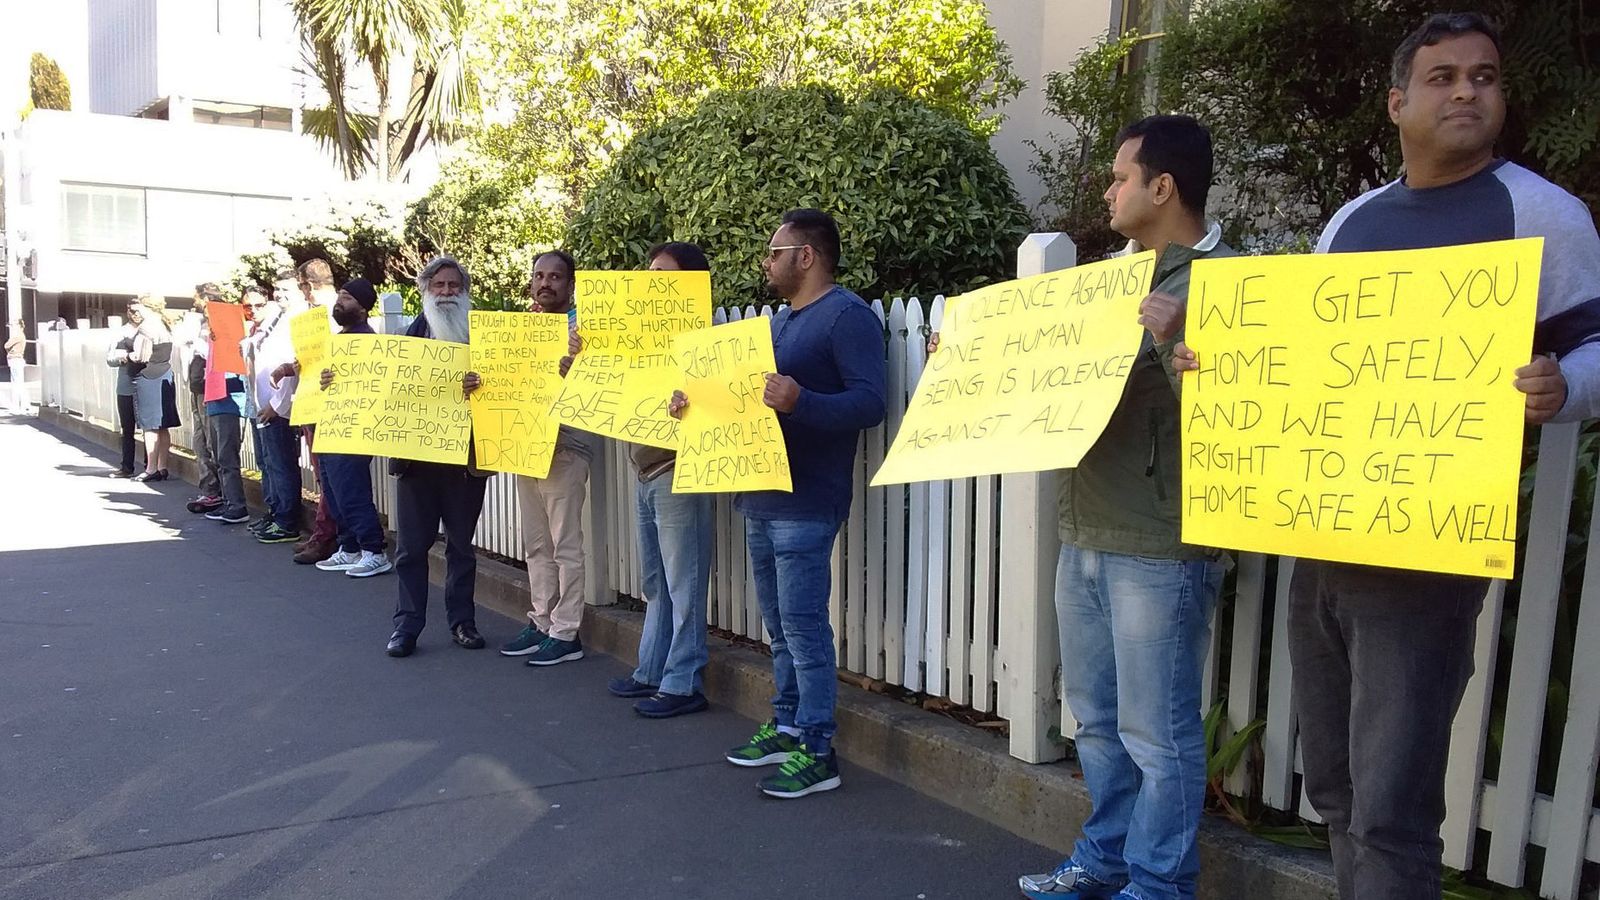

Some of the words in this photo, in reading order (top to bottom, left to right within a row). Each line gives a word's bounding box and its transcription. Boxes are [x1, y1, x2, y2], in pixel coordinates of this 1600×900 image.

[582, 275, 634, 297] DON'T
[648, 277, 680, 297] ASK
[1065, 258, 1154, 308] AGAINST
[581, 301, 615, 315] WHY
[625, 298, 695, 316] SOMEONE
[1200, 275, 1268, 330] WE
[1313, 271, 1413, 323] GET
[1440, 261, 1519, 318] YOU
[471, 314, 506, 330] ENOUGH
[510, 315, 518, 328] IS
[580, 318, 628, 331] KEEPS
[641, 316, 706, 333] HURTING
[480, 331, 517, 345] ACTION
[524, 331, 560, 343] NEEDS
[582, 336, 610, 351] YOU
[616, 335, 644, 351] ASK
[932, 336, 985, 372] ONE
[1003, 320, 1084, 357] HUMAN
[331, 339, 362, 358] WE
[371, 339, 410, 359] ARE
[422, 344, 462, 363] NOT
[472, 351, 482, 362] TO
[485, 349, 496, 360] BE
[502, 348, 537, 359] TAKEN
[579, 355, 623, 368] KEEP
[629, 354, 678, 369] LETTIN
[728, 337, 743, 365] TO
[749, 337, 758, 360] A
[1197, 346, 1291, 392] HOME
[1324, 333, 1502, 389] SAFELY,
[331, 362, 388, 378] ASKING
[397, 365, 422, 381] FOR
[430, 368, 467, 383] FAVO
[472, 363, 523, 374] AGAINST
[530, 361, 555, 375] FARE
[574, 370, 625, 386] THEM
[996, 368, 1017, 397] IS
[1031, 354, 1137, 393] VIOLENCE
[328, 381, 352, 396] BUT
[356, 379, 381, 393] THE
[391, 382, 426, 398] FARE
[431, 386, 447, 399] OF
[480, 378, 514, 388] VASION
[521, 378, 547, 389] AND
[472, 391, 527, 402] VIOLENCE
[558, 387, 623, 416] WE
[320, 413, 361, 426] WAGE
[374, 414, 406, 429] YOU
[324, 399, 377, 412] JOURNEY
[385, 400, 428, 415] WHICH
[437, 406, 449, 419] IS
[549, 401, 595, 427] FOR
[597, 416, 614, 433] A
[1188, 400, 1263, 433] AND
[1282, 401, 1344, 438] WE
[1369, 400, 1486, 440] HAVE
[488, 408, 547, 437] TAXI
[899, 414, 1012, 453] AGAINST
[1019, 400, 1084, 435] ALL
[319, 427, 353, 439] HAVE
[417, 435, 432, 447] TO
[434, 437, 470, 454] DENY
[681, 417, 777, 459] WORKPLACE
[676, 448, 771, 489] EVERYONE'S
[1190, 442, 1280, 476] RIGHT
[1300, 449, 1345, 482] TO
[1363, 451, 1454, 485] GET
[1189, 485, 1259, 519] HOME
[1275, 489, 1354, 531] SAFE
[1367, 496, 1411, 534] AS
[1429, 500, 1517, 543] WELL
